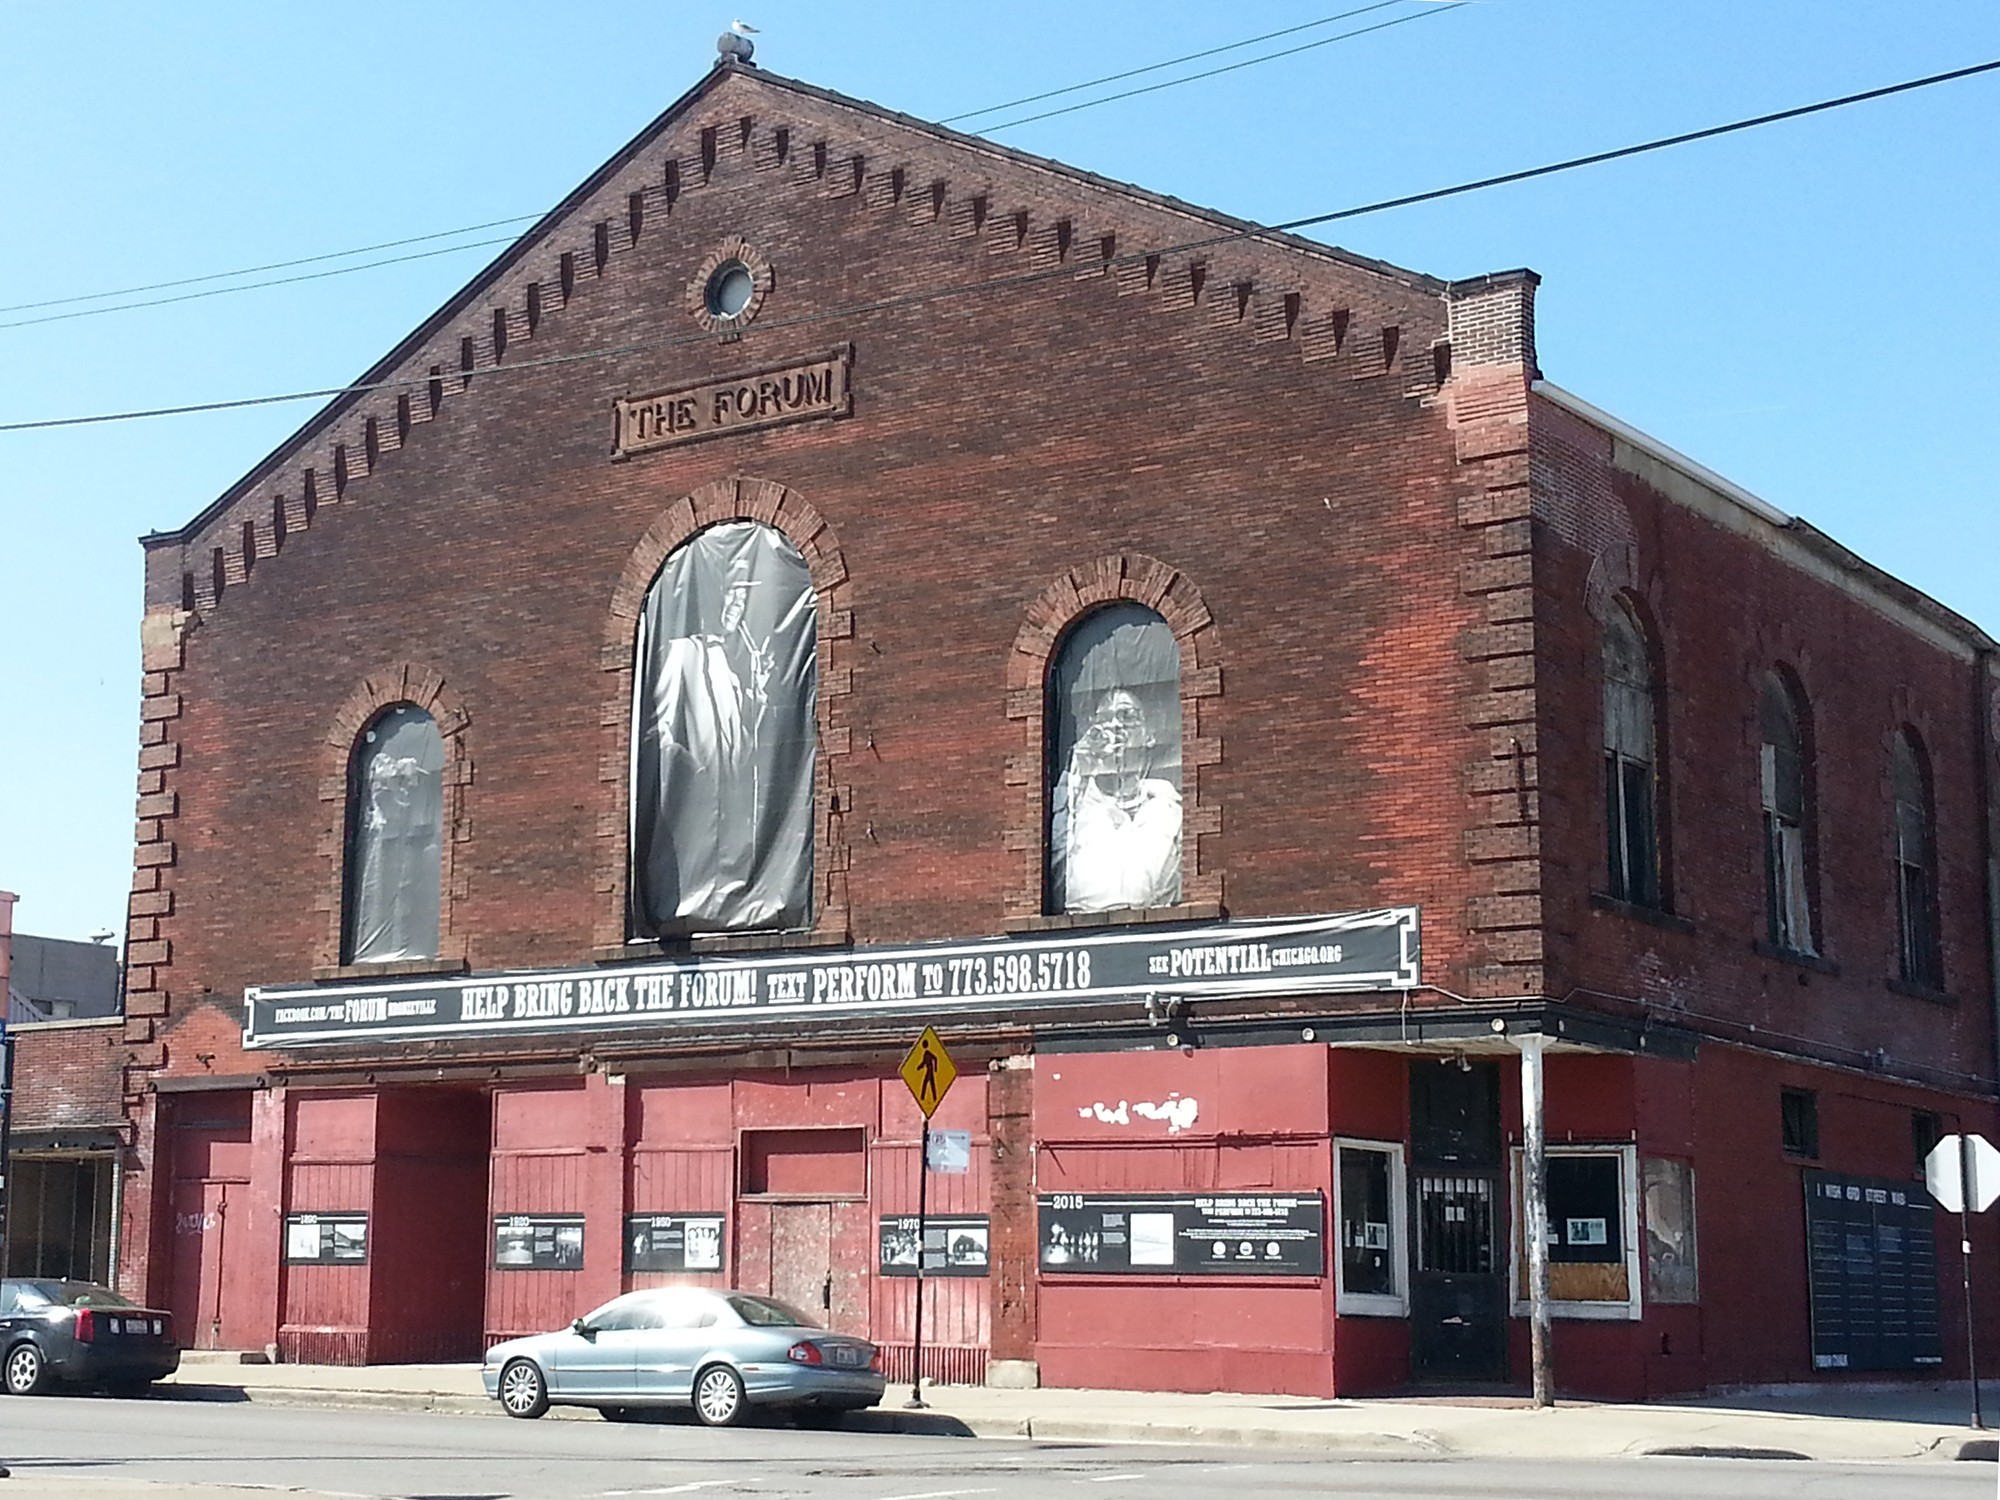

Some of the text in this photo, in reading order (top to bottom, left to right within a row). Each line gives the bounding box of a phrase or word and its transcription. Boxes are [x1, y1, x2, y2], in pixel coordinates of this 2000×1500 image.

[630, 367, 832, 440] THE FORUM
[1149, 943, 1343, 977] SEE POTENTIAL CHICAGO.ORG
[461, 950, 1092, 1020] HELP BRING BACK THE FORUM! TEXT PERFORM TO 773.598.5718
[344, 998, 388, 1023] FORUM
[1053, 1195, 1083, 1210] 2015
[898, 1218, 920, 1230] 1970
